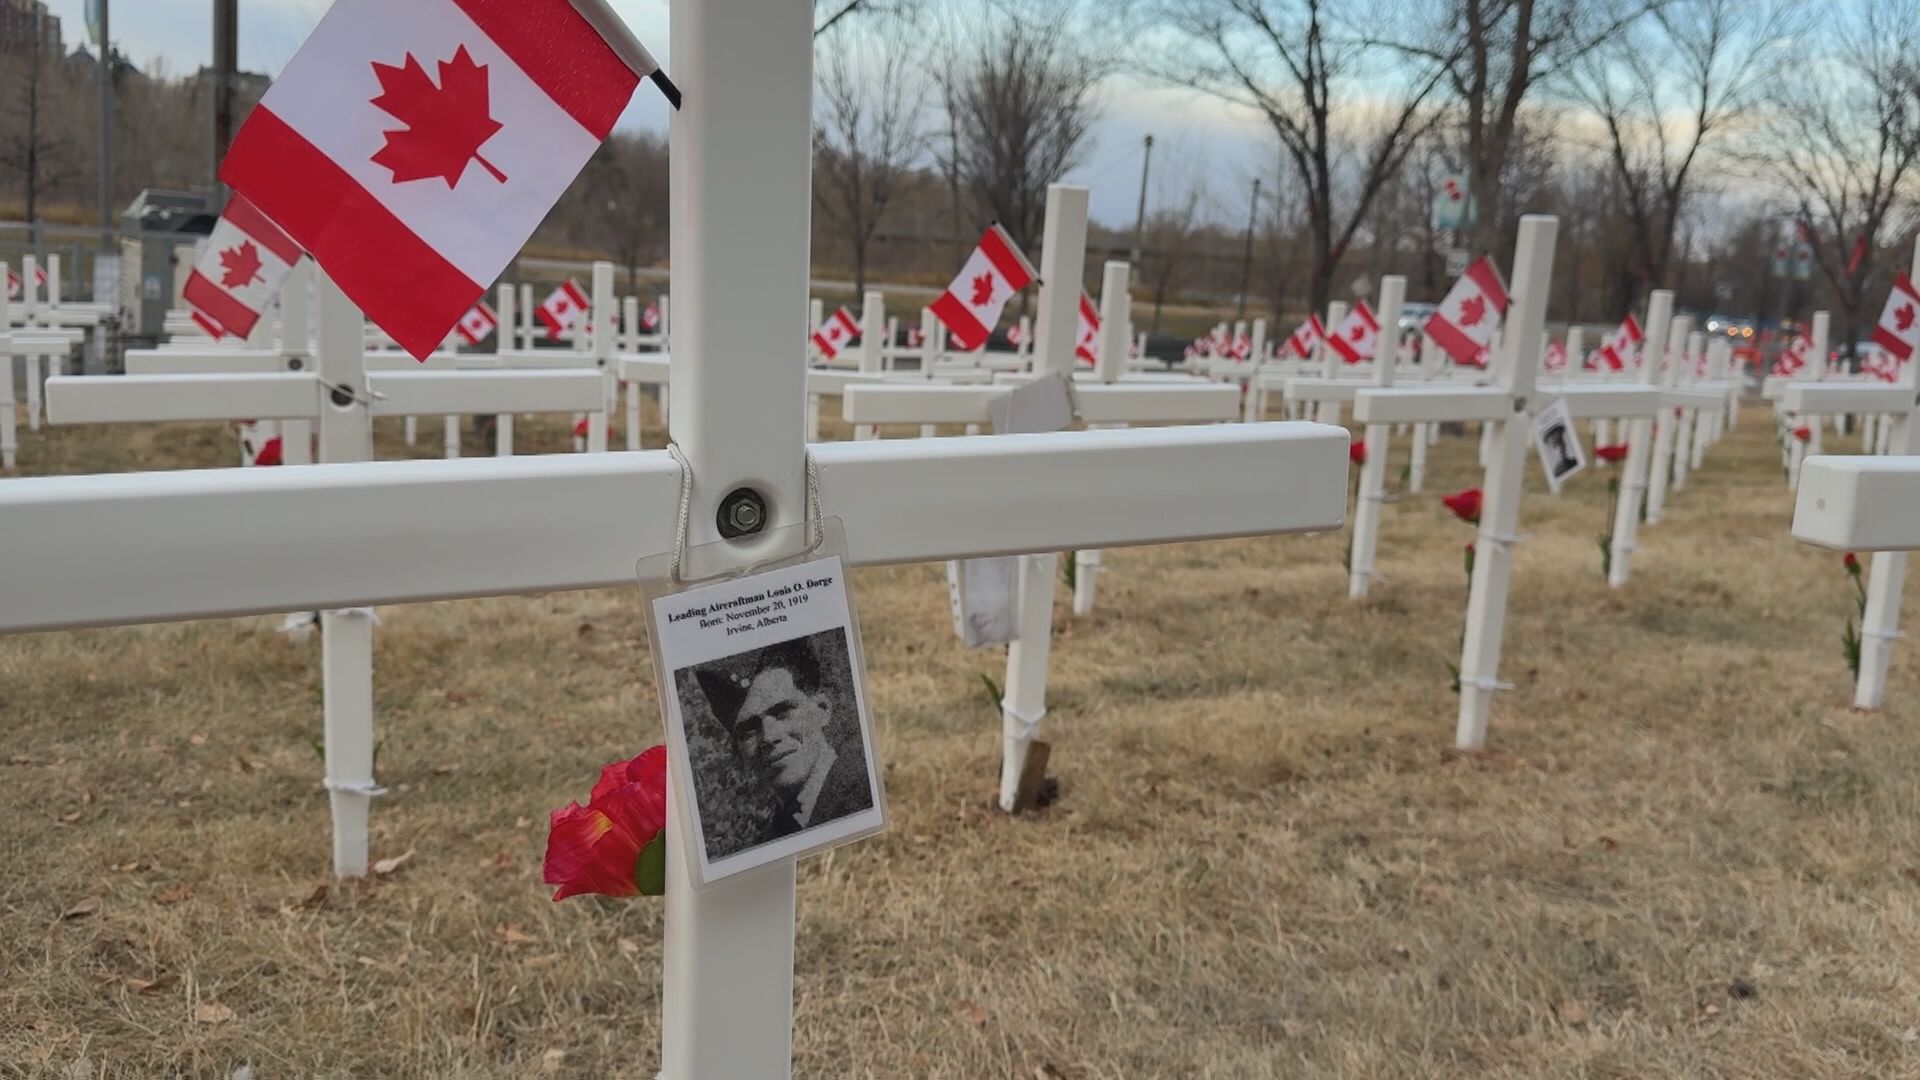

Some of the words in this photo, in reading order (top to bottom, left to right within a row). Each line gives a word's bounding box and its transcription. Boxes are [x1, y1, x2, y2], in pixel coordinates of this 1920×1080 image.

[667, 607, 707, 623] Leading
[708, 593, 765, 613] Aircraftman
[767, 585, 792, 598] Louis
[793, 583, 805, 592] O.
[699, 617, 724, 629] Born:
[725, 605, 770, 622] November
[788, 594, 809, 607] 1919
[757, 615, 788, 628] Alberta
